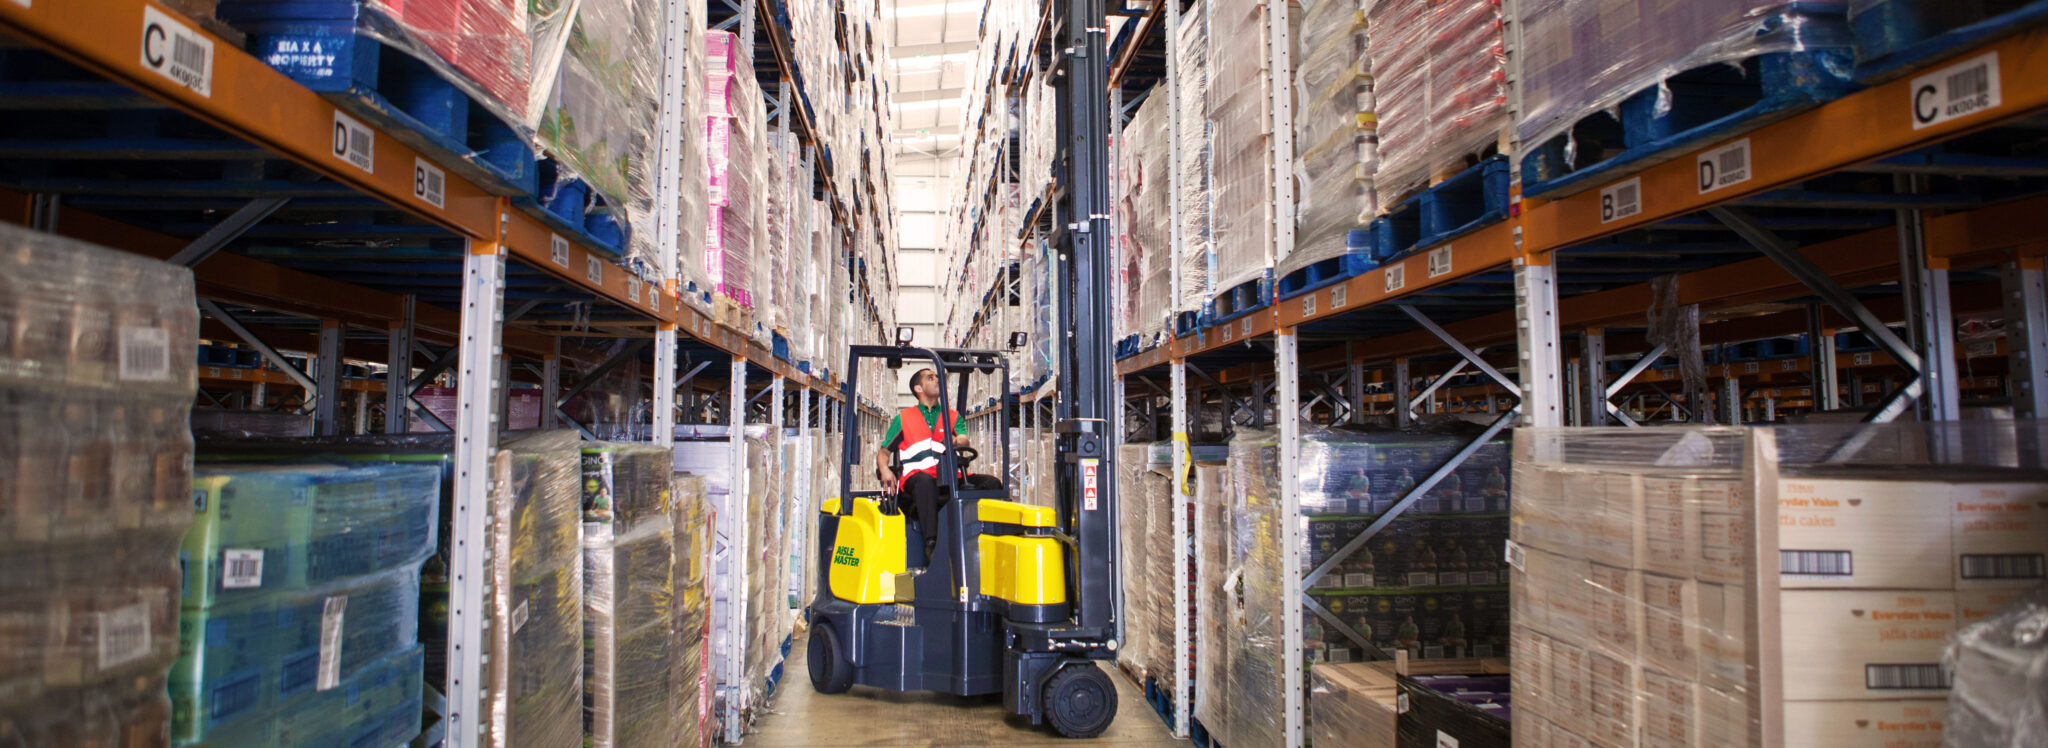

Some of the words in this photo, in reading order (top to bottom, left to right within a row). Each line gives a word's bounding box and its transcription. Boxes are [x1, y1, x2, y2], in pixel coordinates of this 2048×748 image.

[145, 23, 166, 68] C
[1915, 84, 1938, 124] C
[335, 120, 347, 155] D
[416, 165, 425, 196] B
[1700, 160, 1714, 191] D
[1602, 194, 1614, 221] B
[1430, 255, 1437, 275] A
[1386, 272, 1392, 291] C
[1779, 498, 1809, 508] ryday
[1811, 497, 1839, 507] Value
[1799, 514, 1836, 527] cakes
[834, 555, 860, 567] MASTER
[837, 546, 855, 557] AISLE
